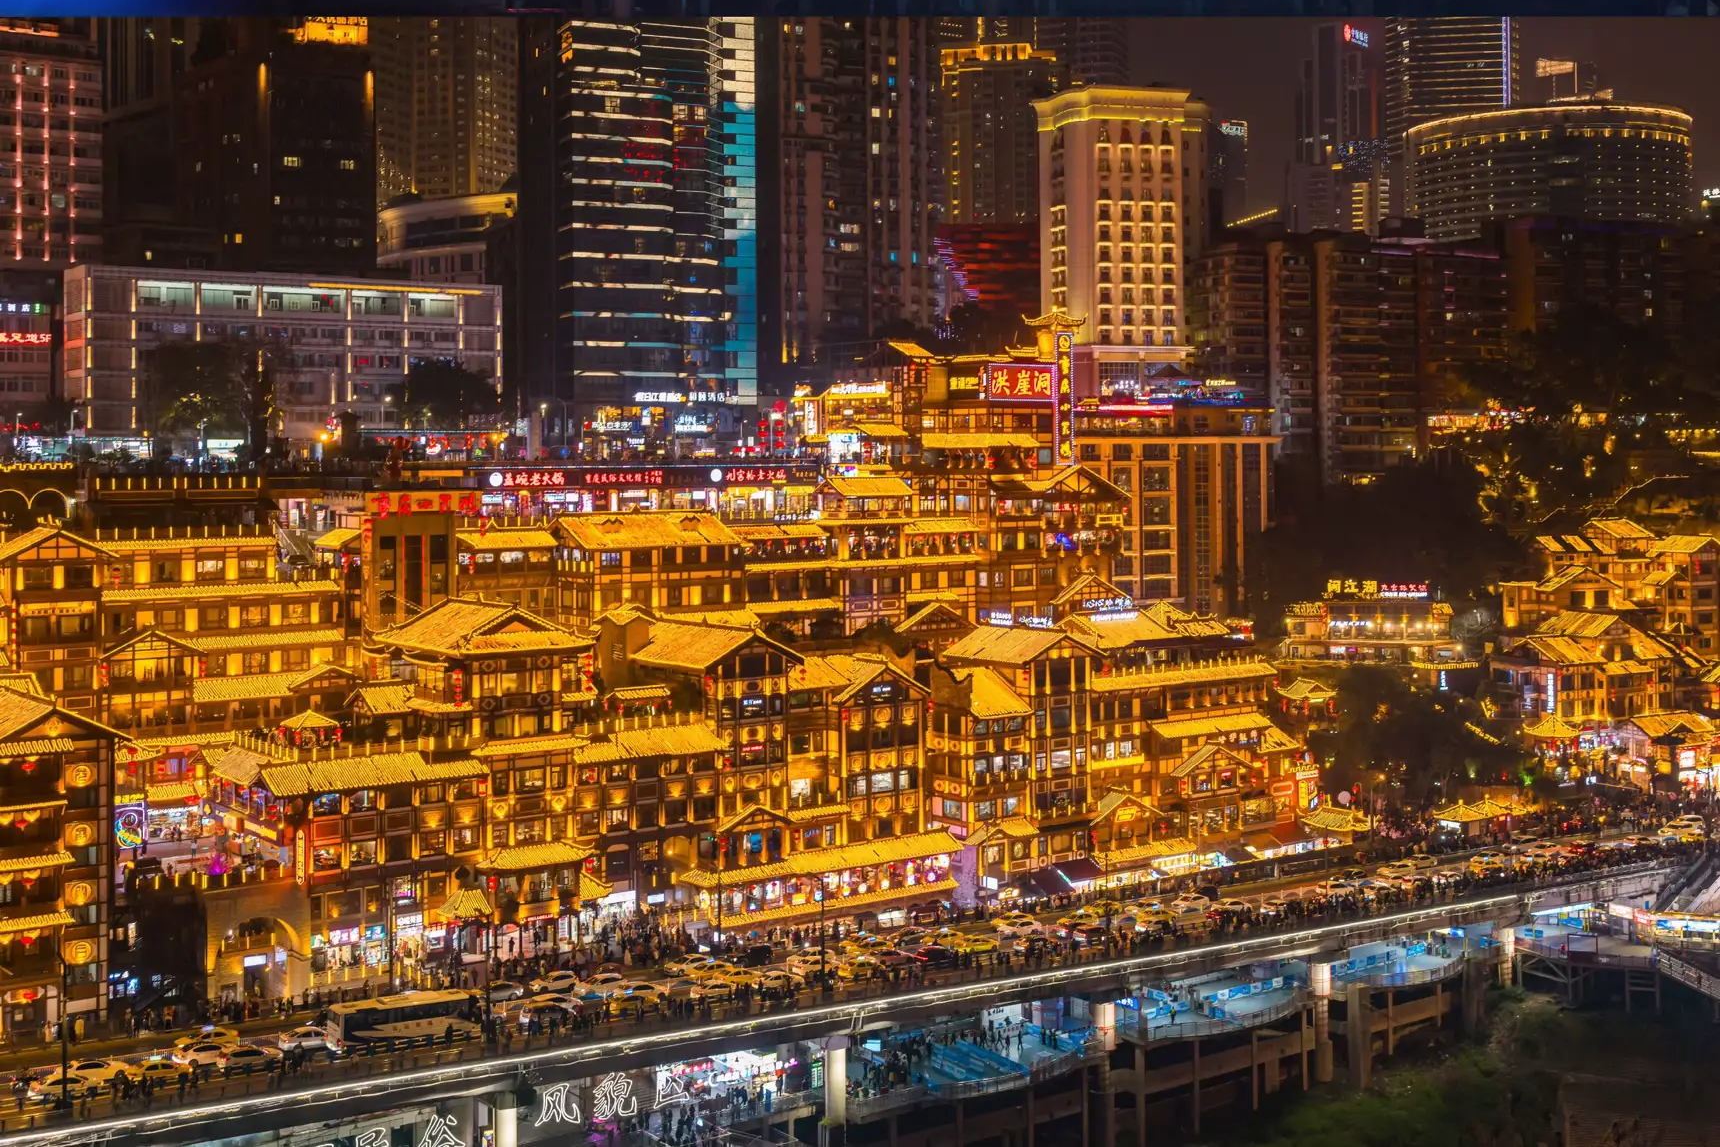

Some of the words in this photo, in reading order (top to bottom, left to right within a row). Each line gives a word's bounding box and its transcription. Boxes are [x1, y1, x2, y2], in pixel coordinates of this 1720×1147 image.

[992, 369, 1051, 396] 洪崖洞
[503, 472, 565, 486] 盖碗老火锅
[535, 1072, 690, 1126] 风貌区
